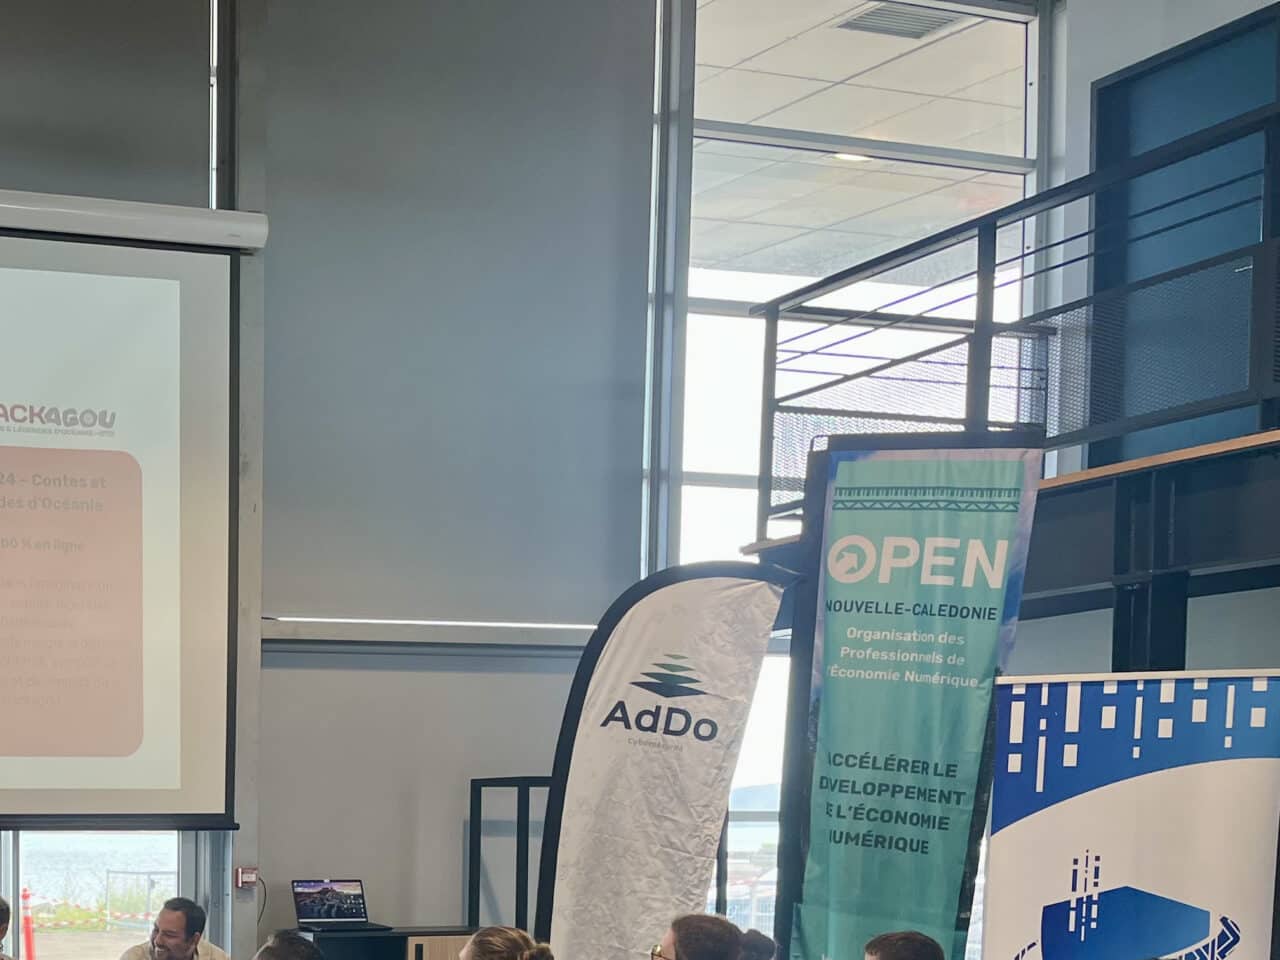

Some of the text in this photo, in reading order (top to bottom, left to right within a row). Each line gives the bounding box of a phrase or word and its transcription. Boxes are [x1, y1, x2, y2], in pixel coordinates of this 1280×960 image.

[31, 474, 88, 489] Contes
[90, 476, 107, 490] et
[28, 495, 104, 513] d'Océanie
[827, 534, 1009, 590] OPEN
[846, 626, 966, 646] Organisation des
[840, 646, 966, 666] Professionnels de
[904, 670, 979, 689] Numérique
[600, 700, 719, 742] AdDo
[828, 751, 959, 779] CCÉLÉRER LE
[819, 775, 967, 806] DVELOPPEMENT
[836, 803, 951, 831] L'ÉCONOMIE
